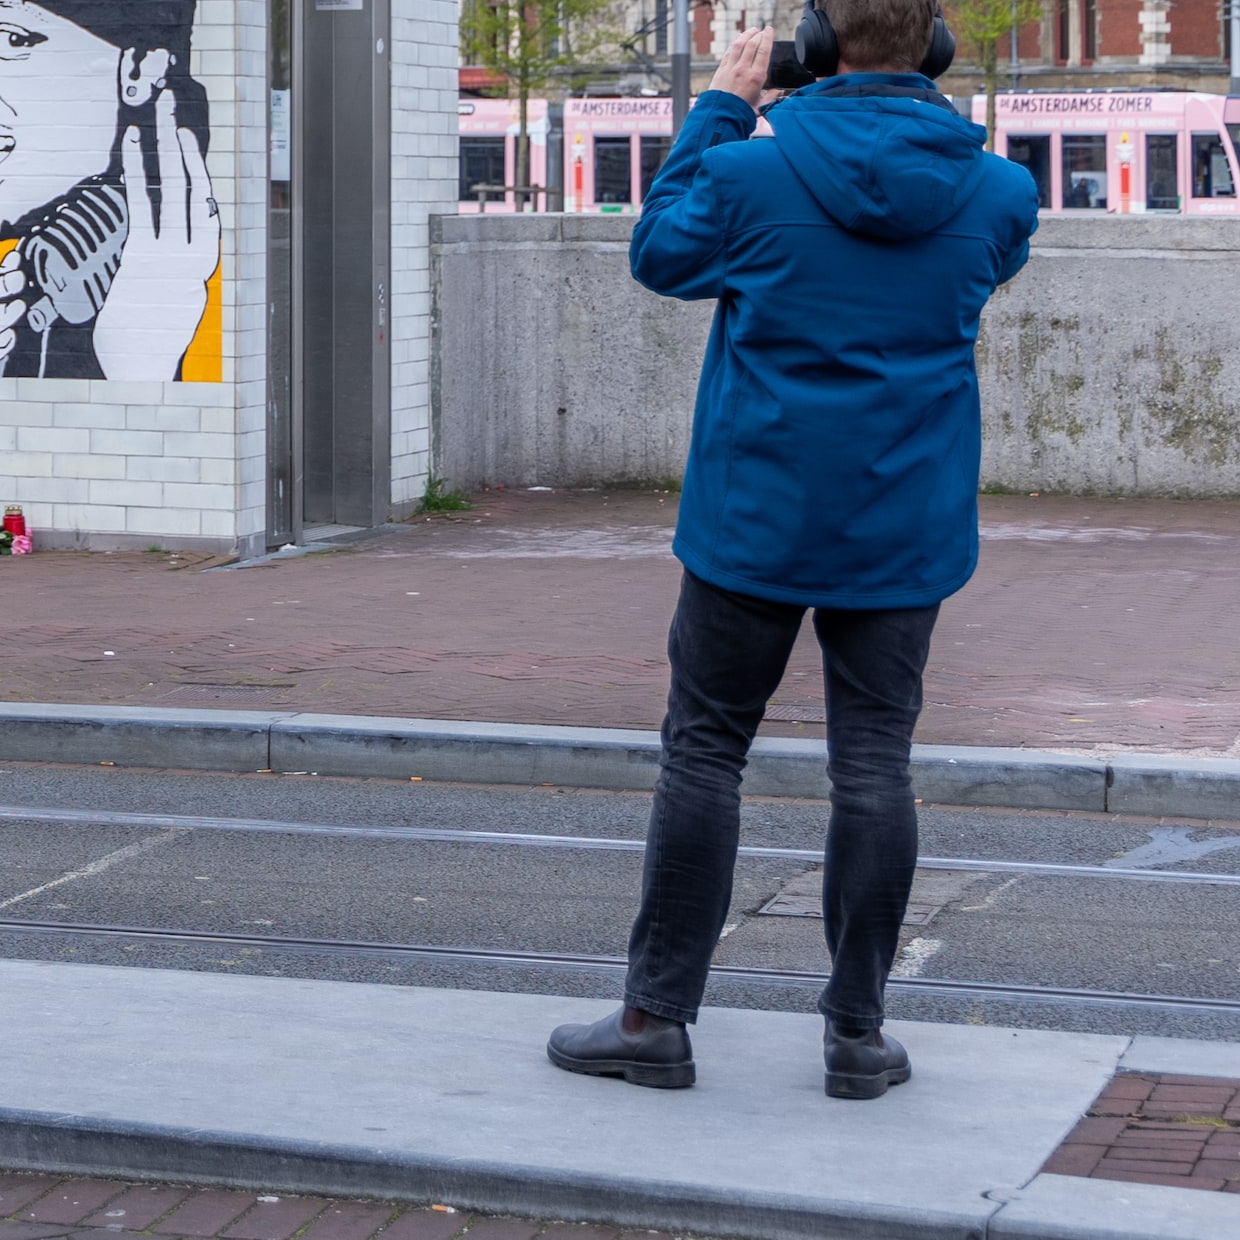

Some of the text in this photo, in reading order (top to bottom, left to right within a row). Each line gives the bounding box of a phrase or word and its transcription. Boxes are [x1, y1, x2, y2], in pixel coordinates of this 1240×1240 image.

[582, 101, 660, 116] AMSTERDAMSE
[1011, 97, 1105, 113] AMSTERDAMSE
[1108, 96, 1153, 112] ZOMER
